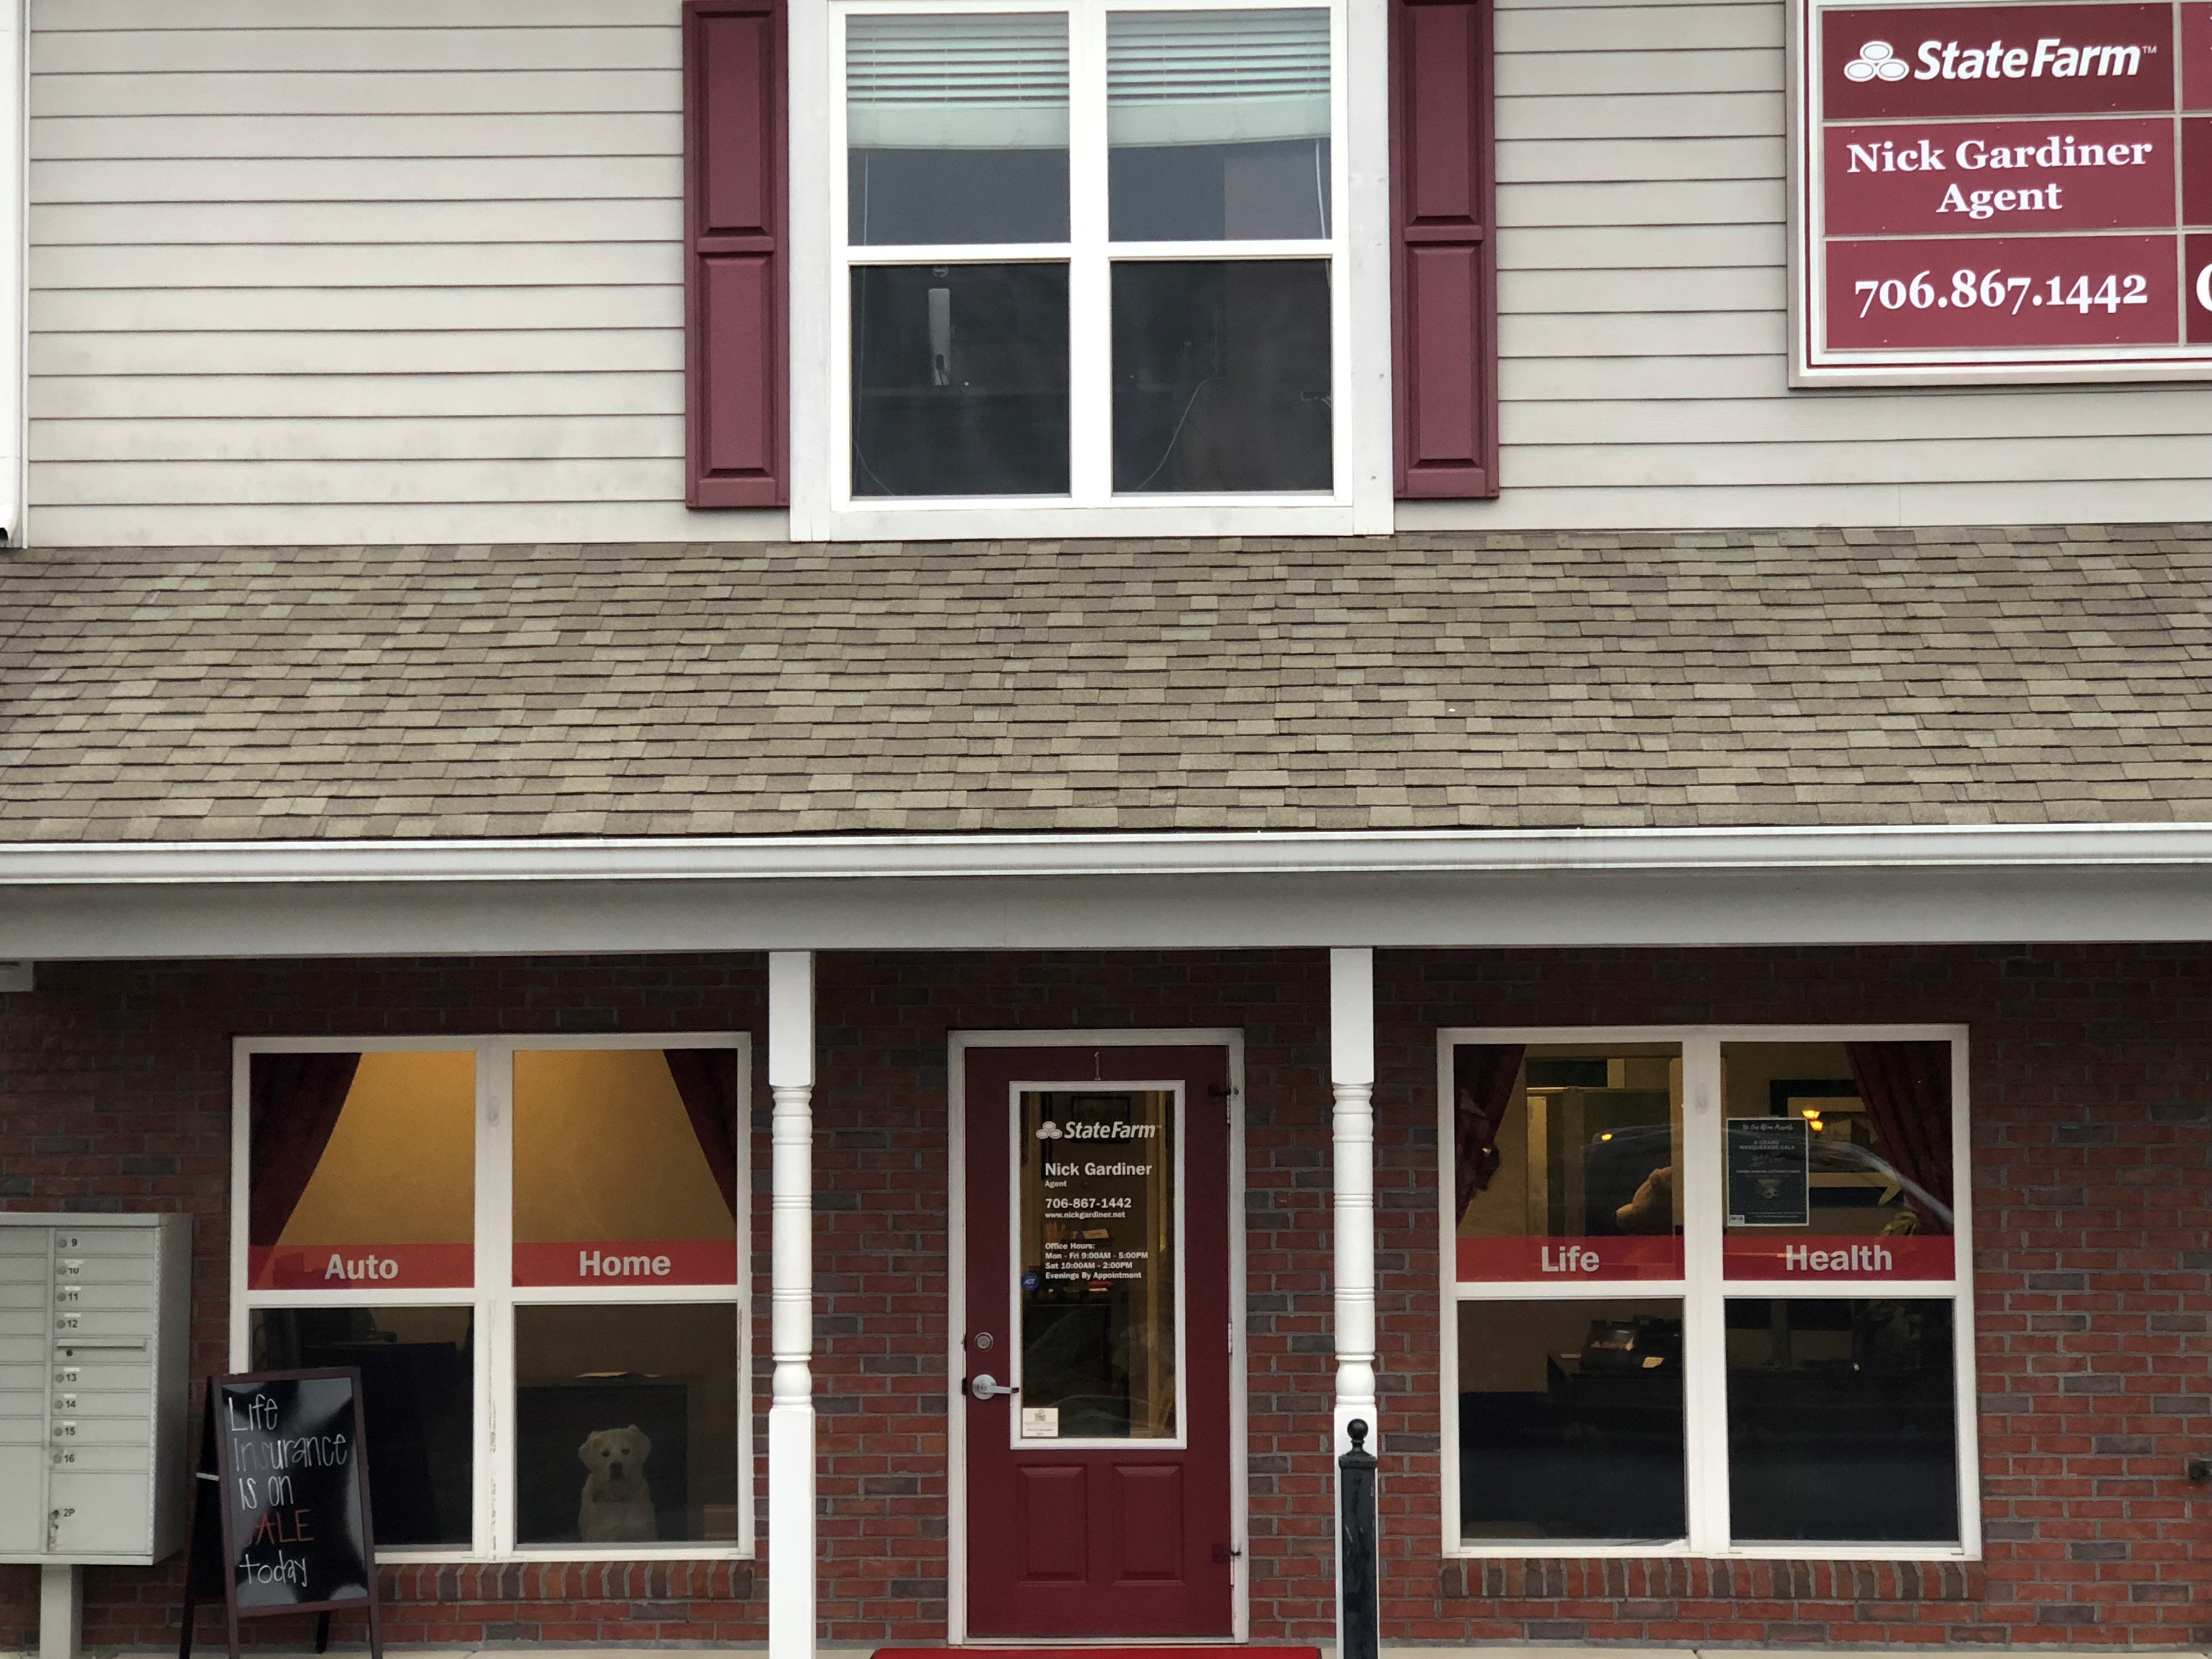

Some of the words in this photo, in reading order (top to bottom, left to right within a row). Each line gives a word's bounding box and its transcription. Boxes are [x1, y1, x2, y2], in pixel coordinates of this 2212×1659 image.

[1847, 140, 1946, 172] Nick
[1955, 136, 2153, 170] Gardiner
[1936, 183, 2063, 219] Agent
[1854, 269, 2148, 318] 706.867.1442
[1045, 1163, 1080, 1176] Nick
[1085, 1162, 1152, 1175] Gardiner
[1045, 1181, 1067, 1189] Agent
[1045, 1198, 1132, 1209] 706-867-1442
[1045, 1211, 1126, 1220] www.nickgardiner.net
[71, 1238, 77, 1246] 9
[580, 1251, 671, 1277] Home
[1541, 1245, 1600, 1272] Life
[1786, 1245, 1893, 1271] Health
[325, 1254, 399, 1280] Auto
[67, 1293, 78, 1301] 11
[67, 1319, 78, 1328] 12
[66, 1400, 76, 1408] 14
[228, 1393, 278, 1432] Life
[65, 1427, 76, 1436] 15
[64, 1454, 75, 1463] 16
[268, 1475, 294, 1506] on
[63, 1509, 75, 1517] 2P
[239, 1550, 308, 1588] today
